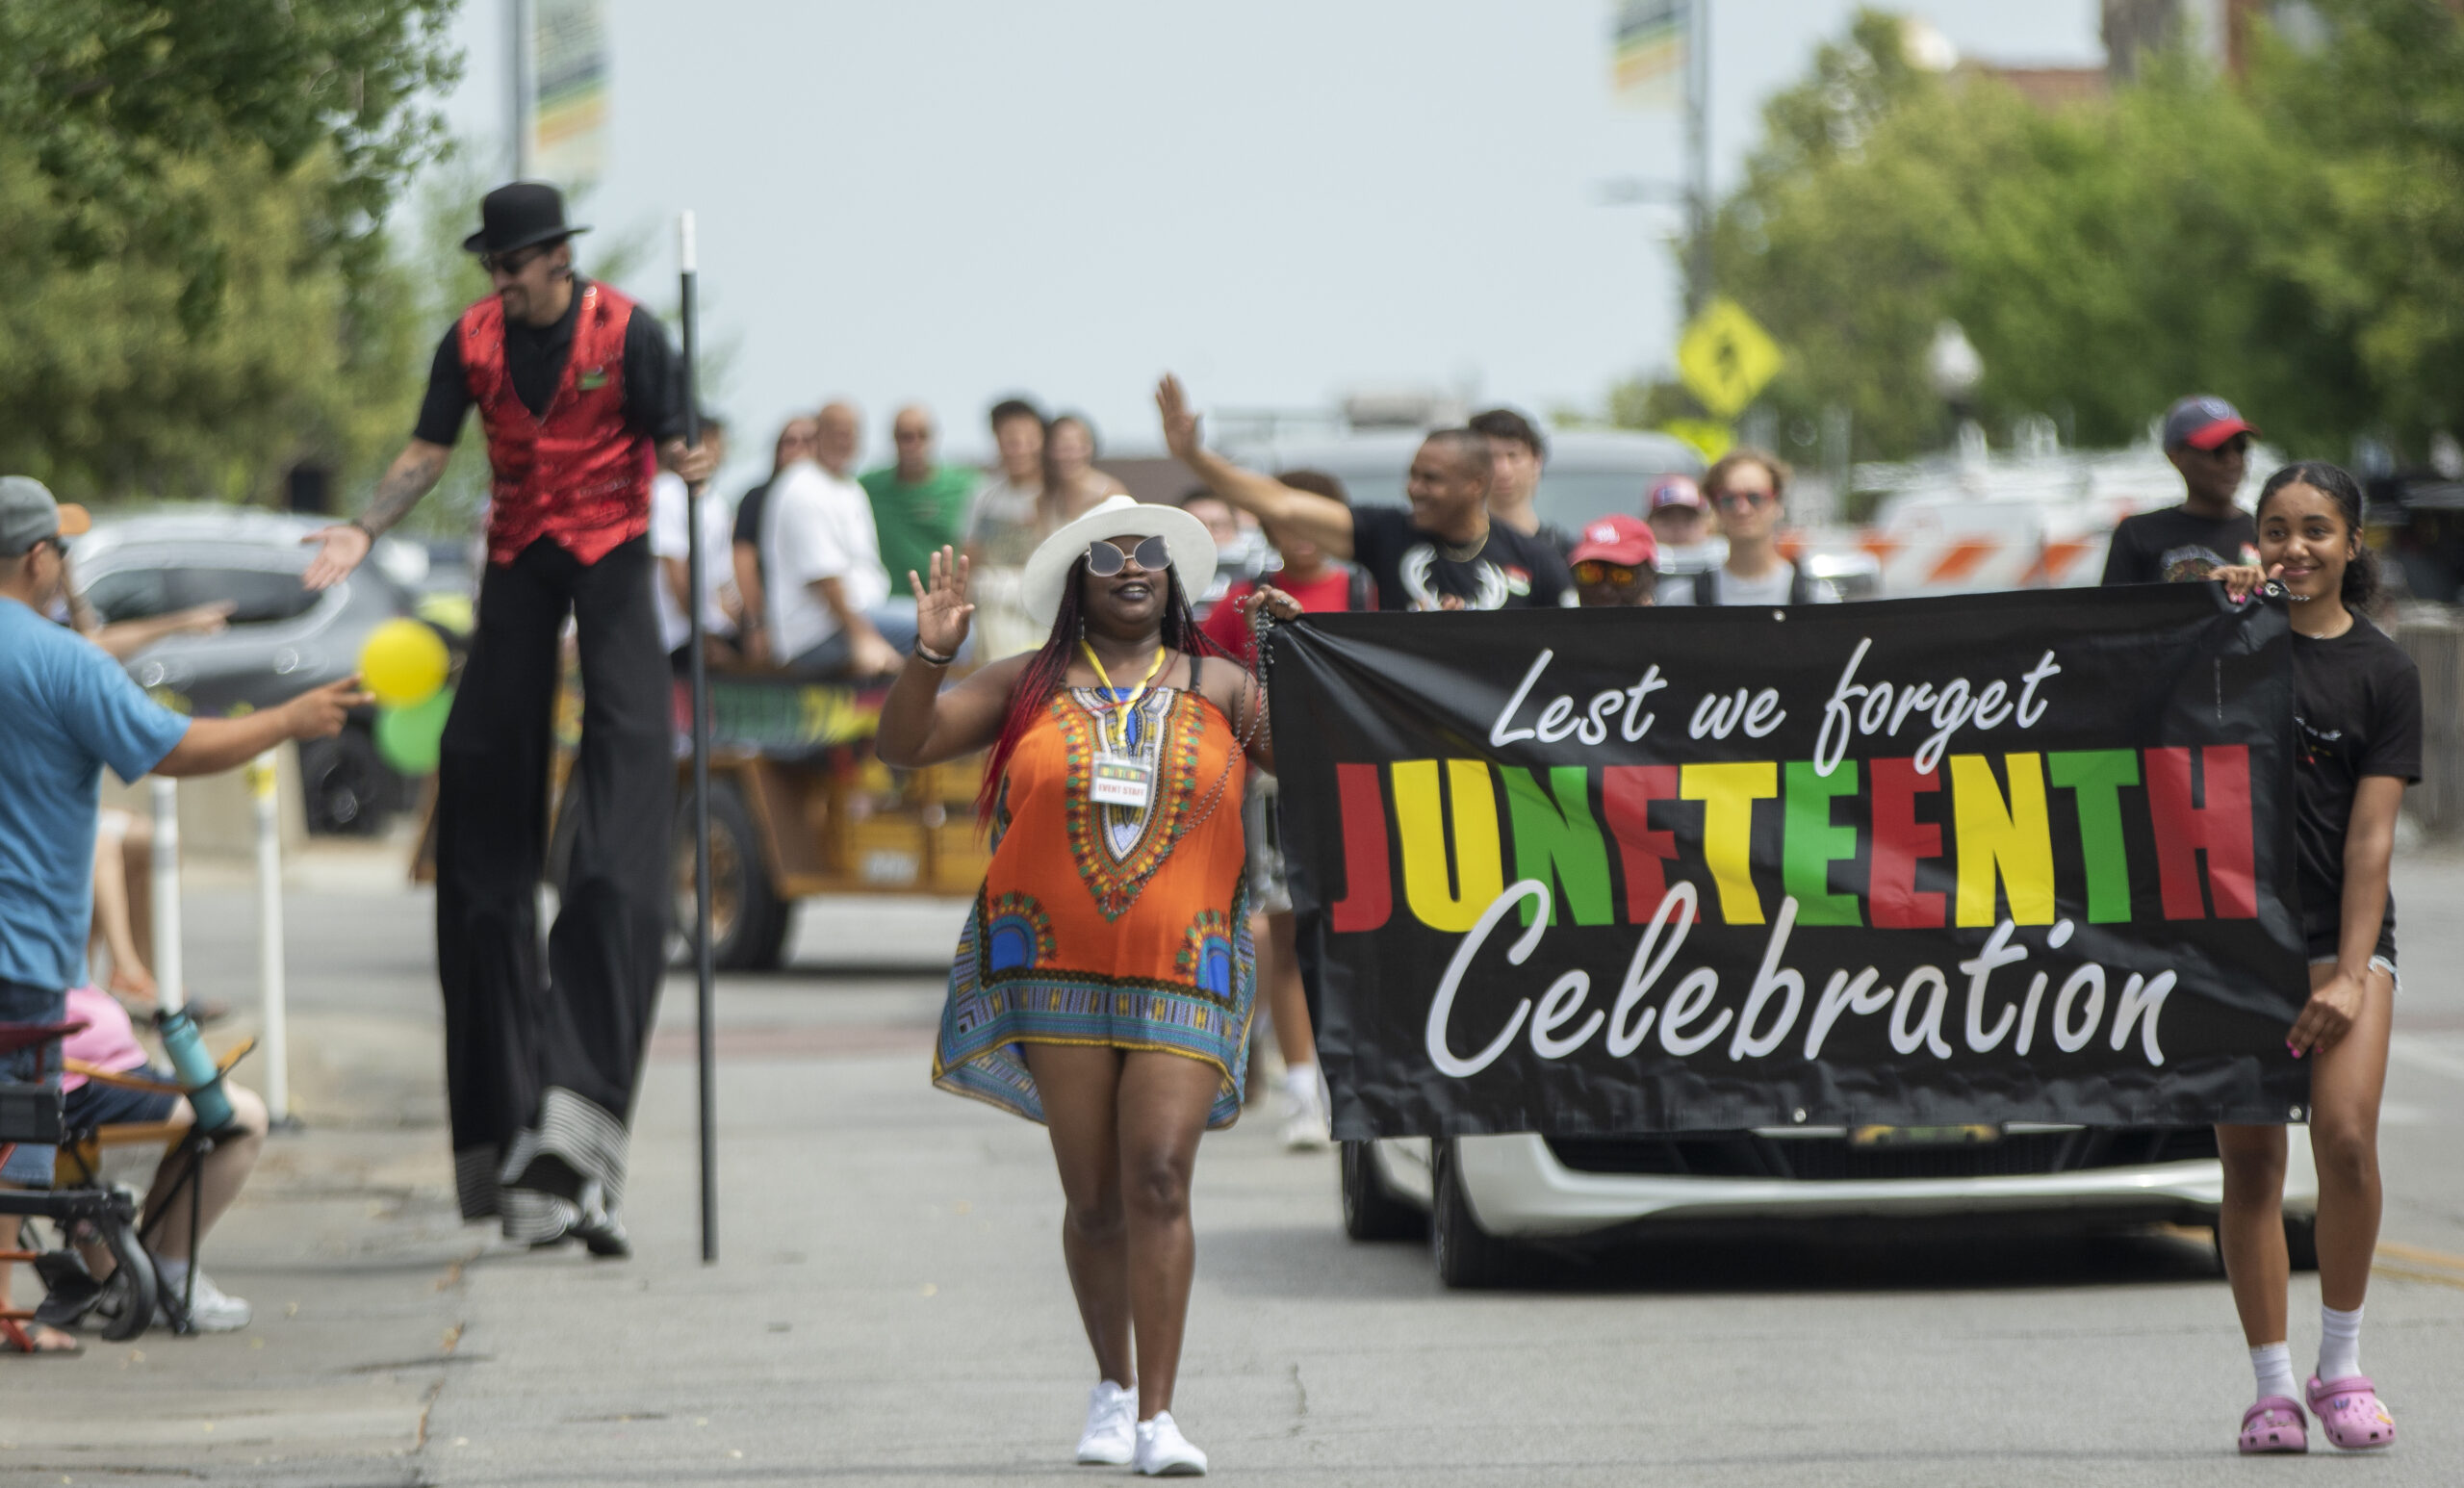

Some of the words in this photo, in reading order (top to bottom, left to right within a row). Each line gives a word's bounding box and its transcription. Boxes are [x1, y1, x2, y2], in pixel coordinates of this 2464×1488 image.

[1491, 649, 1667, 747] Lest
[1689, 687, 1785, 739] we
[1816, 638, 2061, 776] forget
[1333, 746, 2258, 932] JUNETEENTH
[1427, 879, 2177, 1077] Celebration
